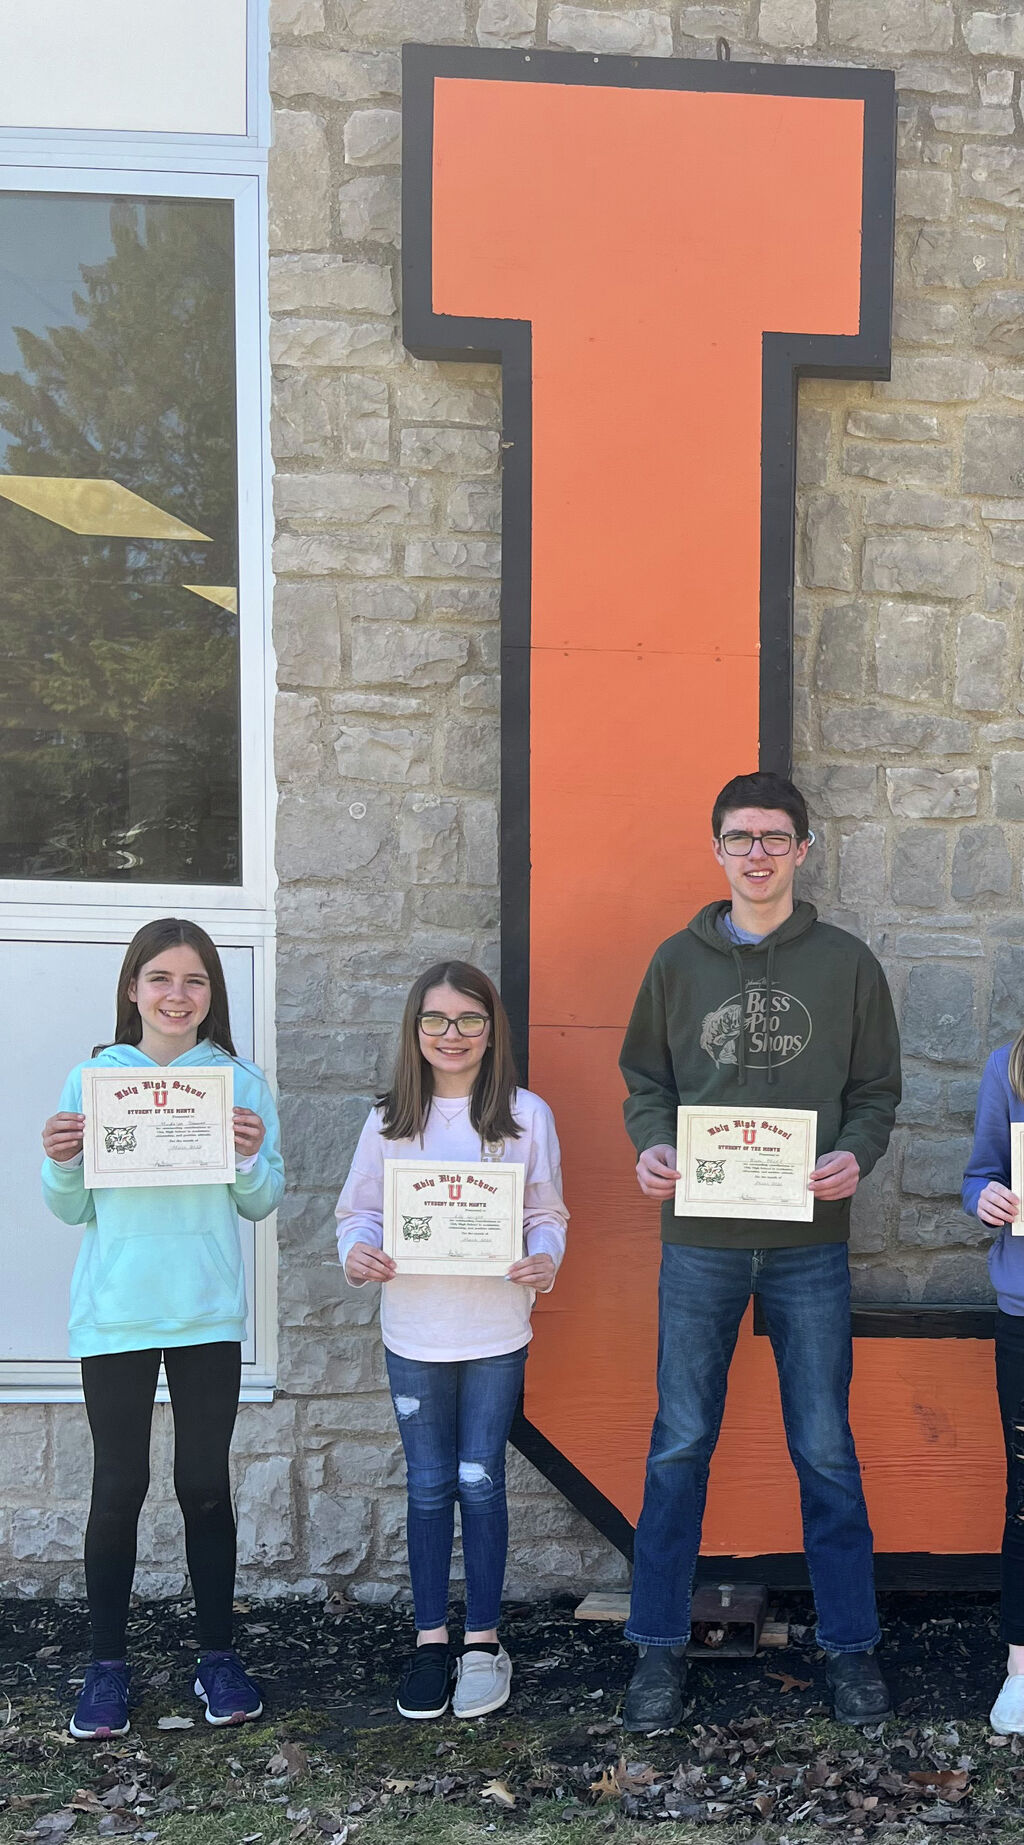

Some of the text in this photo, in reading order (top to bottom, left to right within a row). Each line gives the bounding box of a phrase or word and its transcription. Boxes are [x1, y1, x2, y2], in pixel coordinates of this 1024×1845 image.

[749, 1012, 780, 1033] Pro
[749, 1032, 802, 1056] Shops
[142, 1081, 166, 1090] High
[172, 1081, 206, 1099] School
[153, 1091, 168, 1107] U
[733, 1120, 756, 1128] High
[760, 1121, 792, 1140] School
[742, 1130, 756, 1144] U
[438, 1174, 462, 1183] High
[466, 1176, 498, 1194] School
[448, 1184, 462, 1200] U
